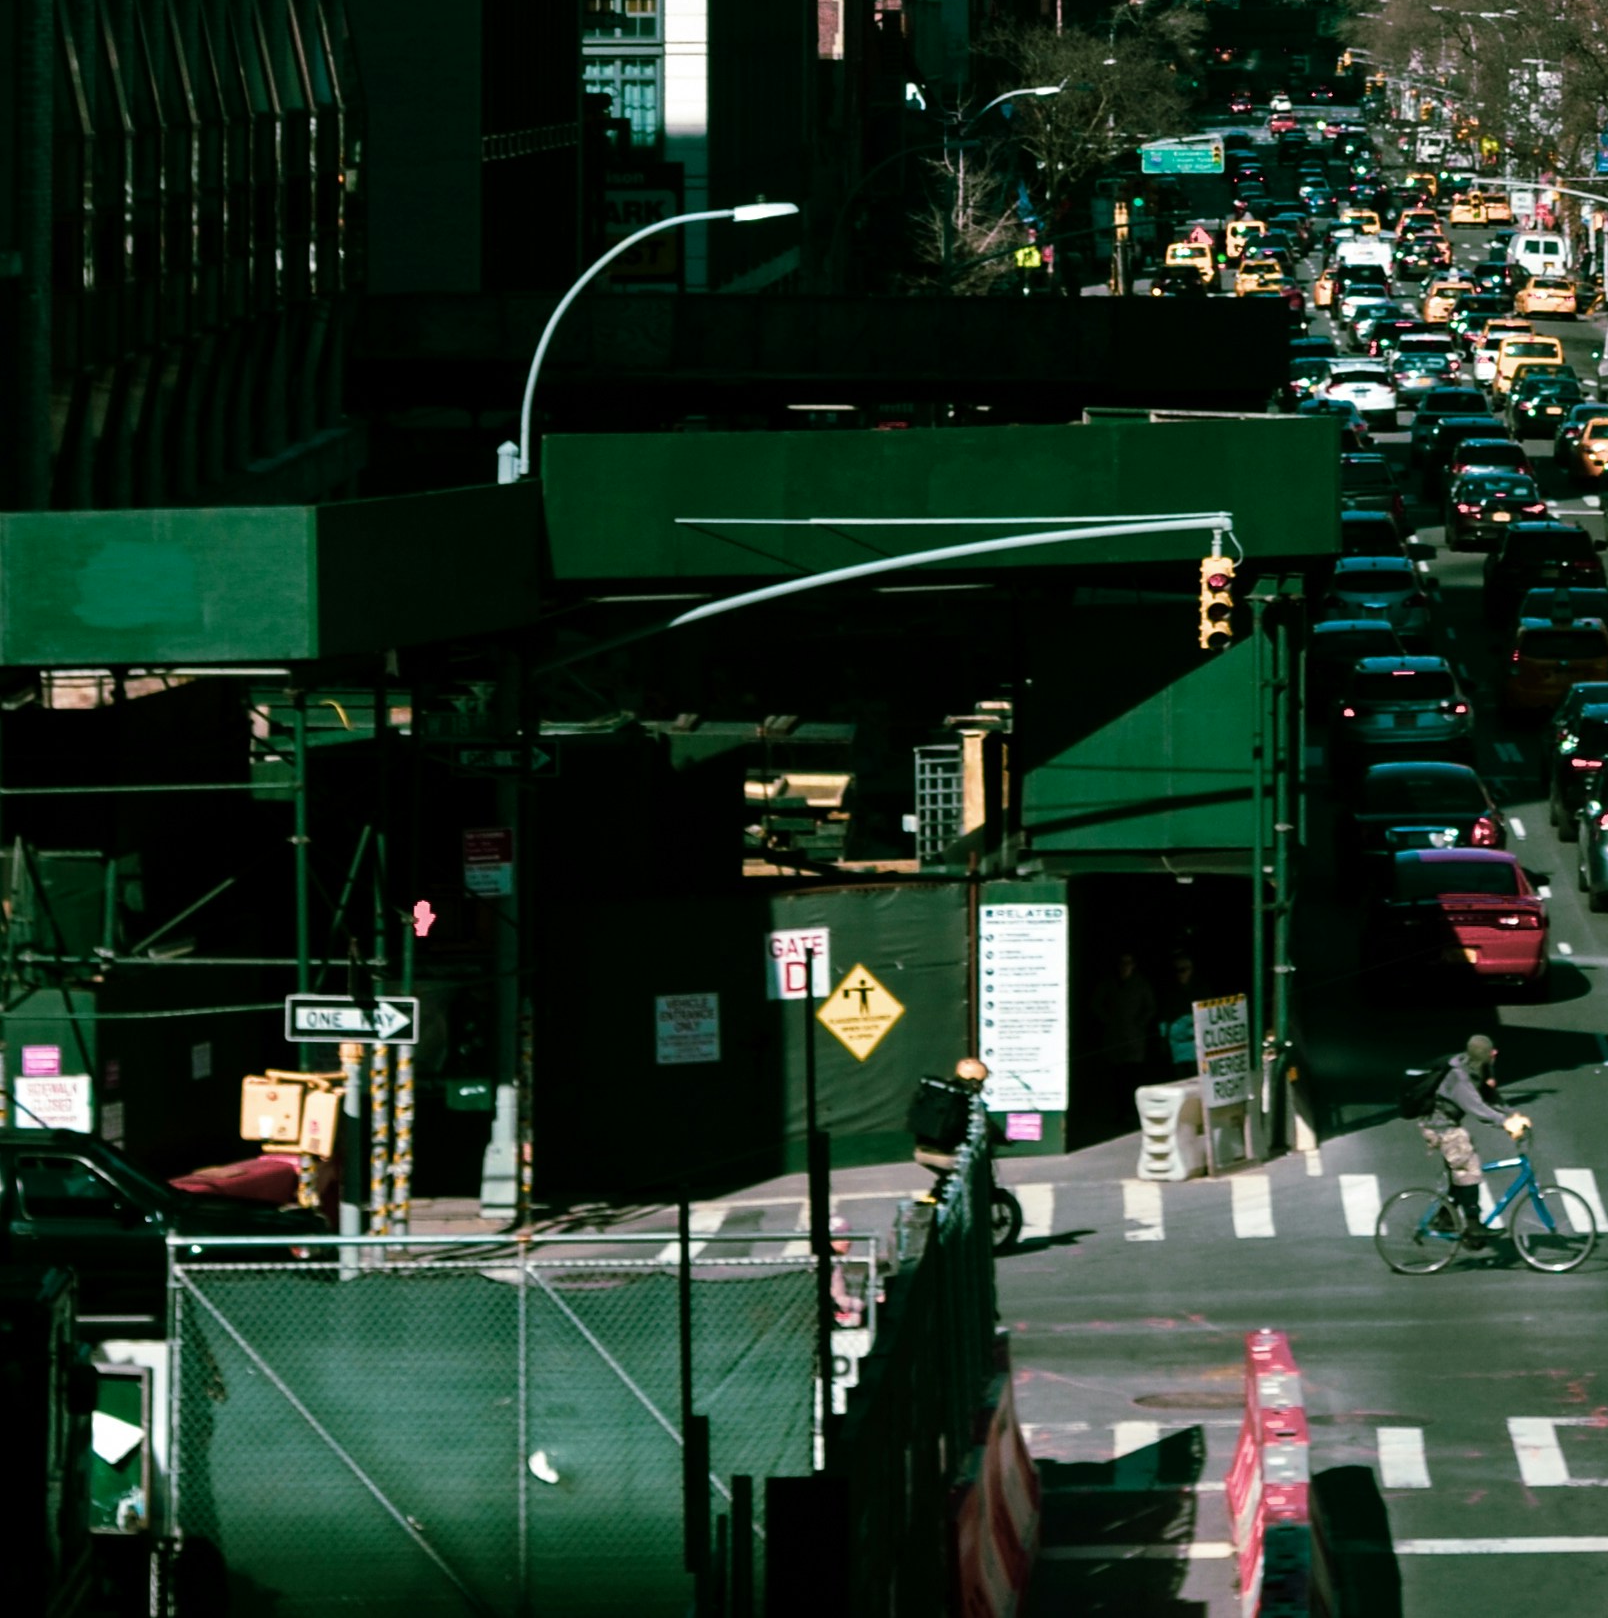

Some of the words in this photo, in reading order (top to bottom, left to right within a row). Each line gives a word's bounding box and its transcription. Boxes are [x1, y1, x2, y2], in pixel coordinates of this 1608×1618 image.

[768, 935, 823, 960] GATE
[785, 962, 813, 993] D
[306, 1011, 343, 1029] ONE
[1208, 1003, 1240, 1025] LANE
[1203, 1024, 1247, 1049] CLOSED
[1209, 1052, 1248, 1077] MERGE
[1214, 1076, 1246, 1100] RIGHT
